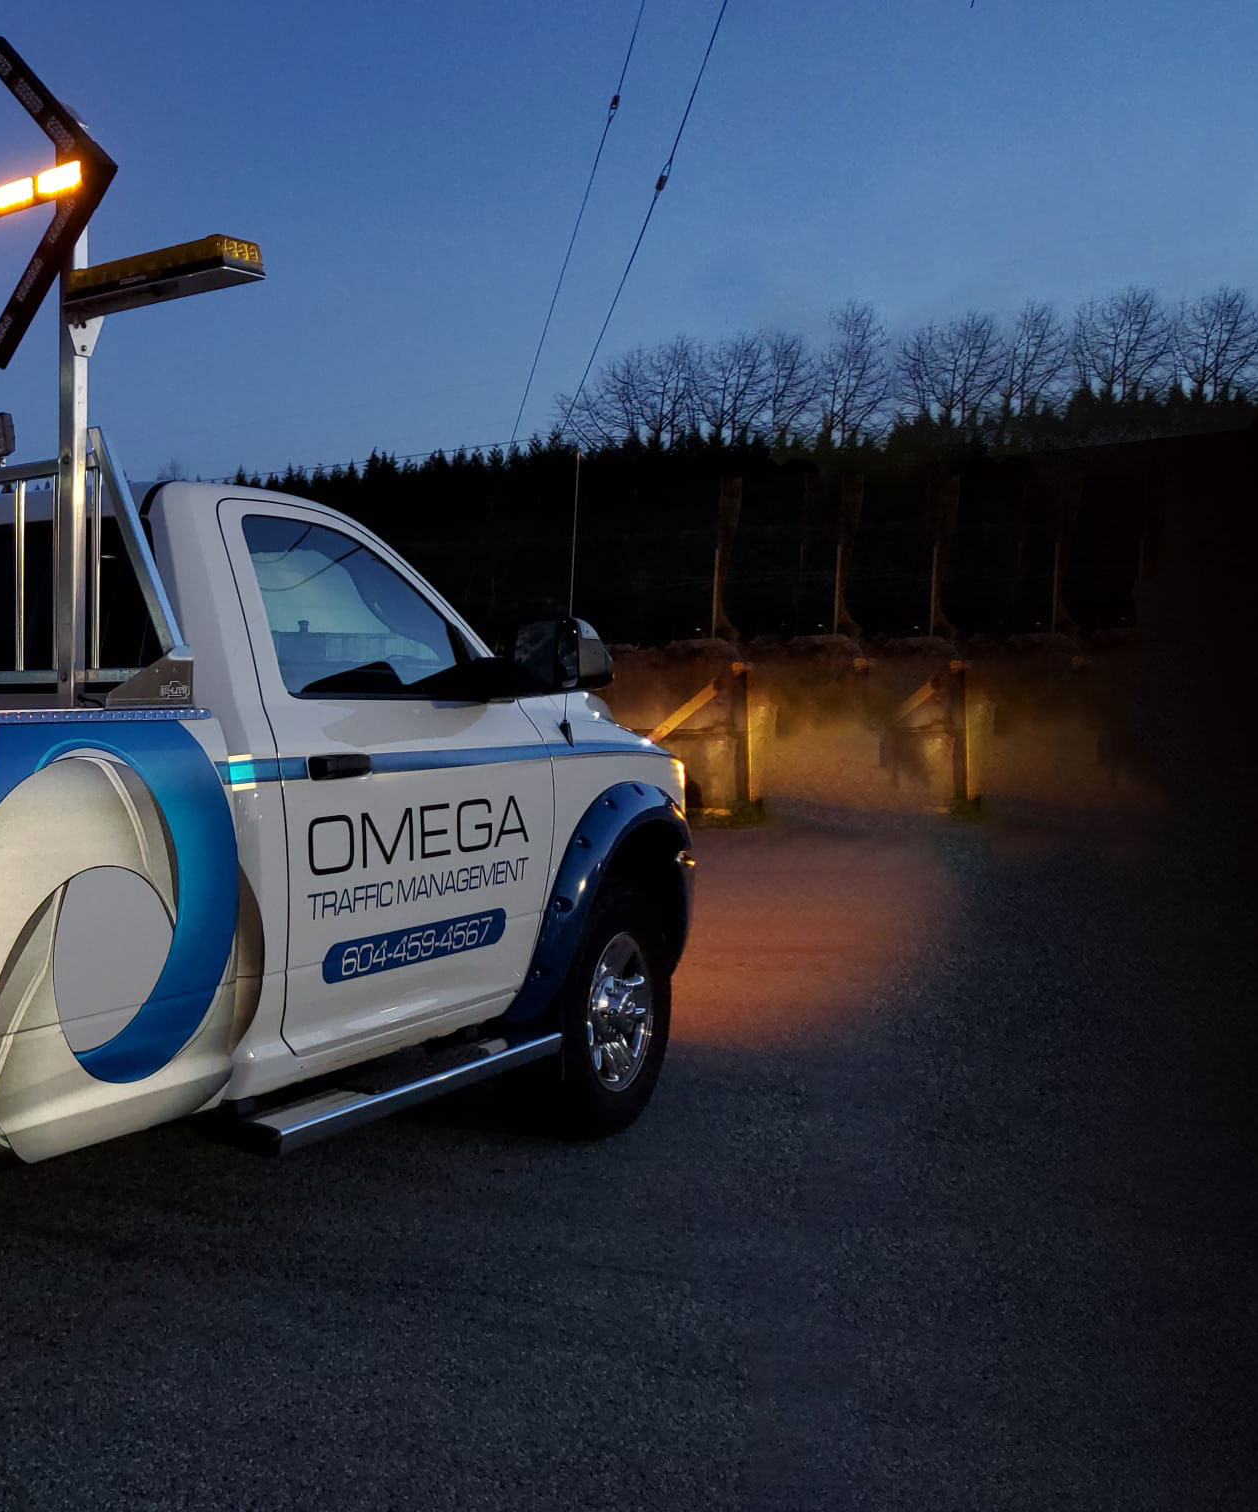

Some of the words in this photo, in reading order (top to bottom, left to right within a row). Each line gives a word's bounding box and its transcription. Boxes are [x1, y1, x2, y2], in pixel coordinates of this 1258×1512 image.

[308, 795, 530, 876] OMEGA
[307, 882, 393, 920] TRAFFIC
[396, 857, 529, 904] MANAGEMENT
[341, 916, 493, 976] 604-459-4567
